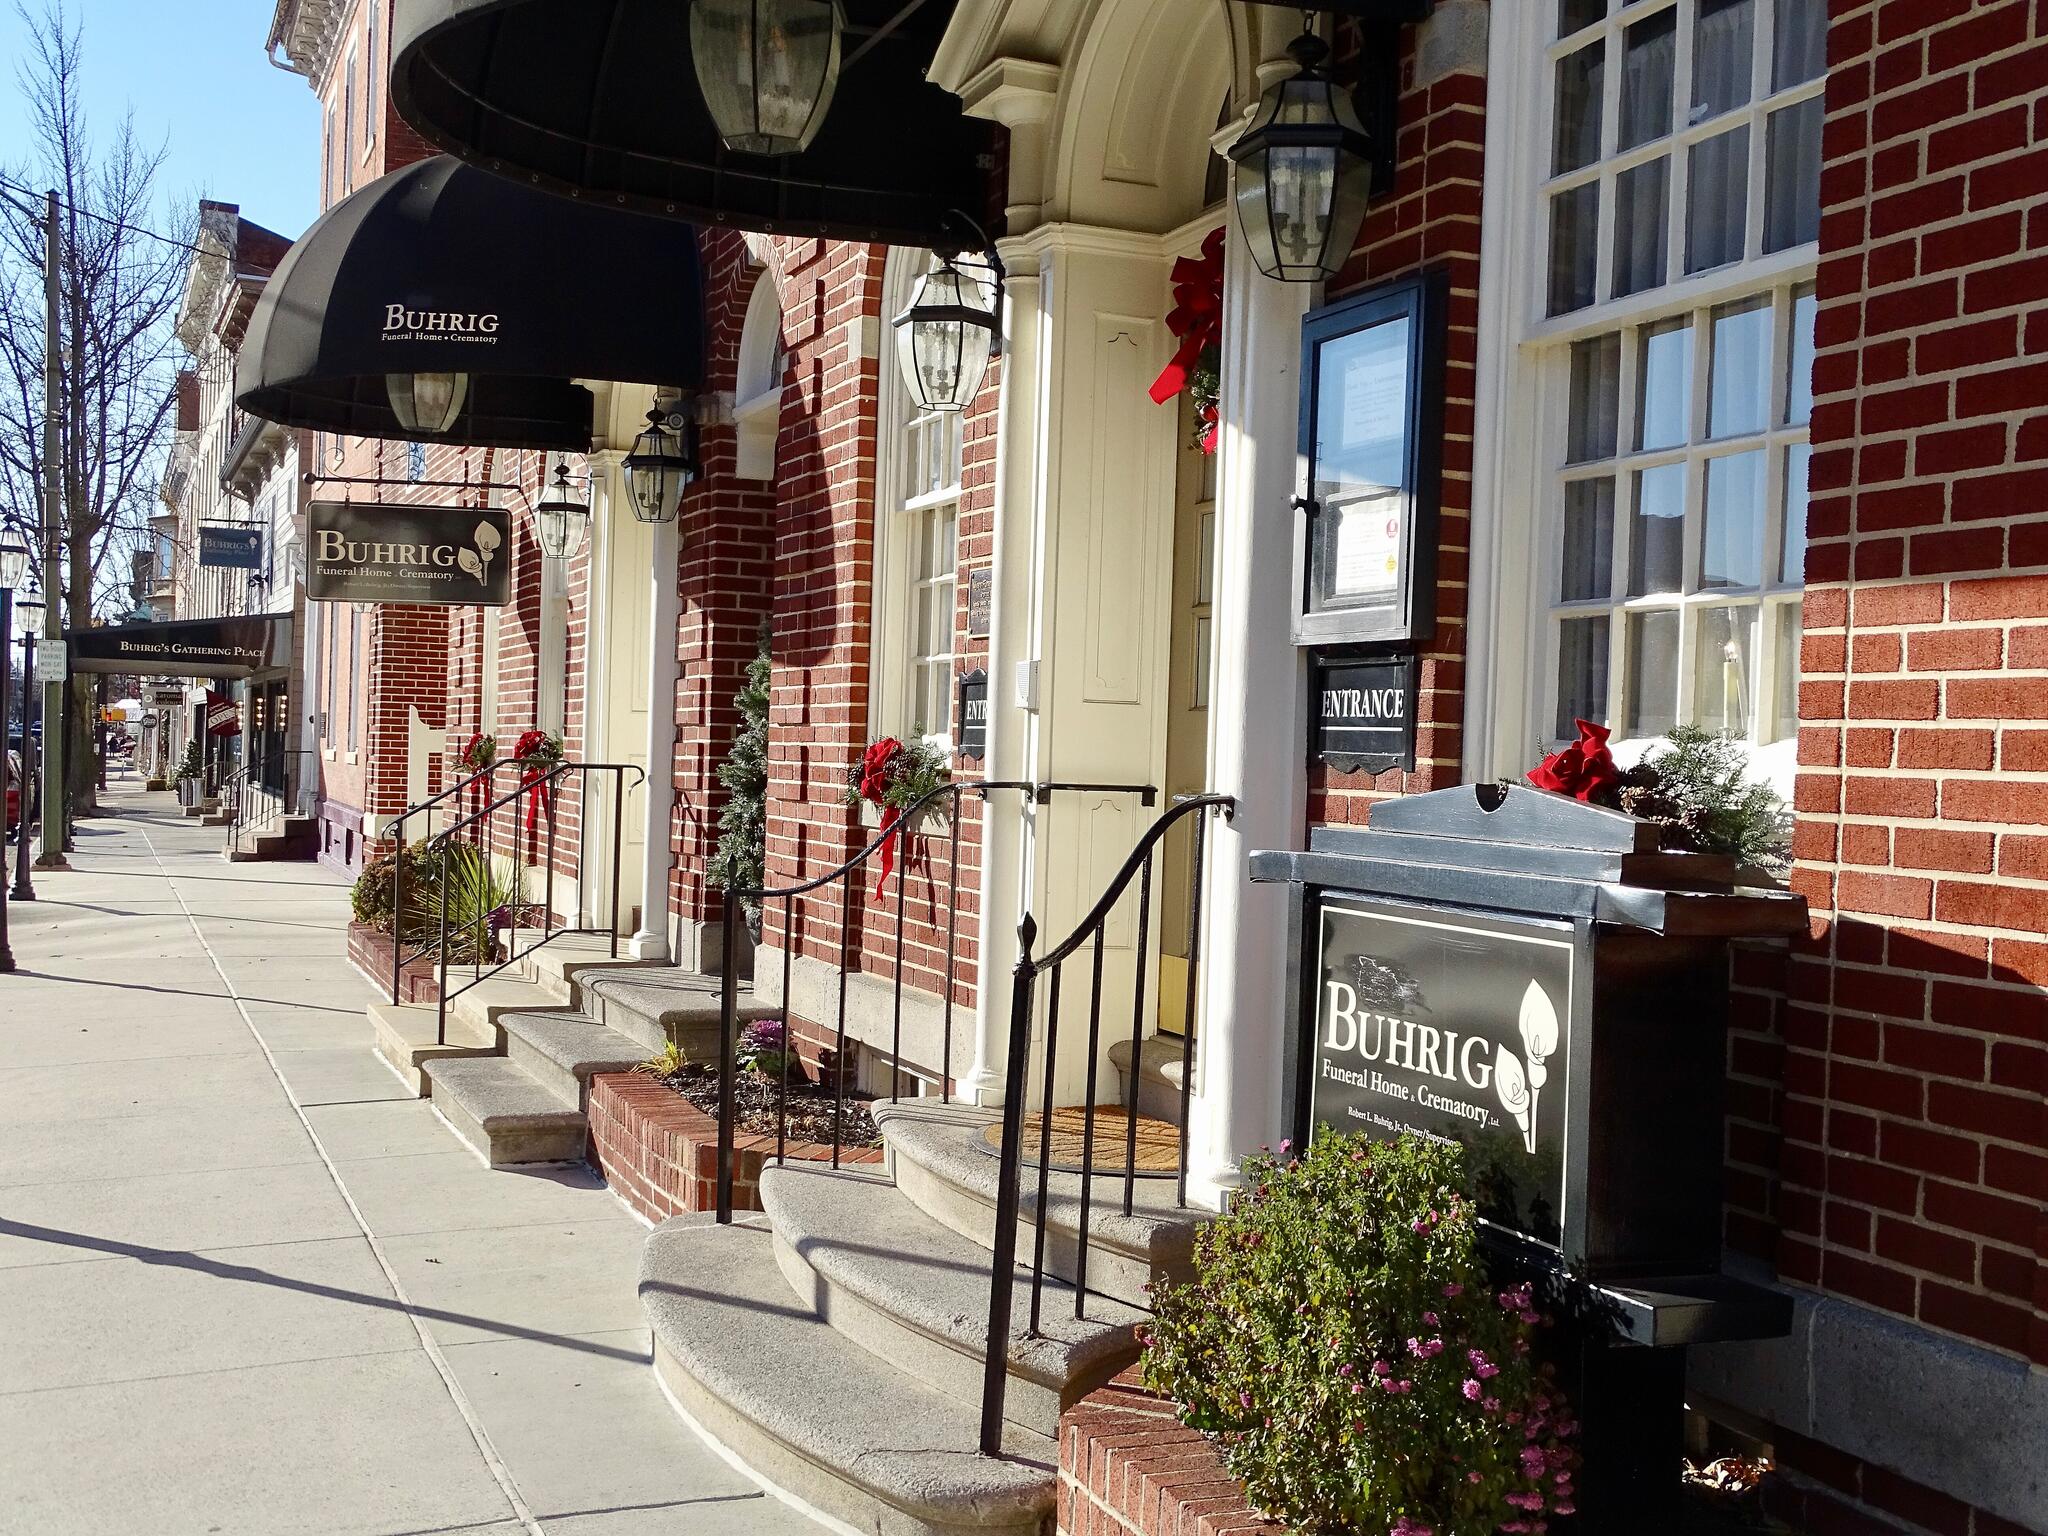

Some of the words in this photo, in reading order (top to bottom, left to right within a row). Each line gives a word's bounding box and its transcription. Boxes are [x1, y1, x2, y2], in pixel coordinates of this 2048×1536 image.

[382, 303, 500, 332] BUHRIG
[381, 332, 412, 341] Funeral
[415, 332, 442, 341] Home
[450, 333, 498, 344] Crematory
[316, 530, 456, 567] BUHRIG
[316, 565, 357, 576] Funeral
[360, 567, 392, 577] Home
[399, 568, 454, 581] Crematory
[120, 640, 170, 653] BUHRIG'S
[171, 643, 232, 656] GATHERING
[233, 646, 266, 657] PLACE
[1321, 688, 1405, 719] ENTRANCE
[1323, 980, 1493, 1090] BUHRIG
[1321, 1058, 1368, 1089] Funeral
[1370, 1071, 1409, 1101] Home
[1347, 1106, 1367, 1121] Robert
[1366, 1111, 1373, 1122] L.
